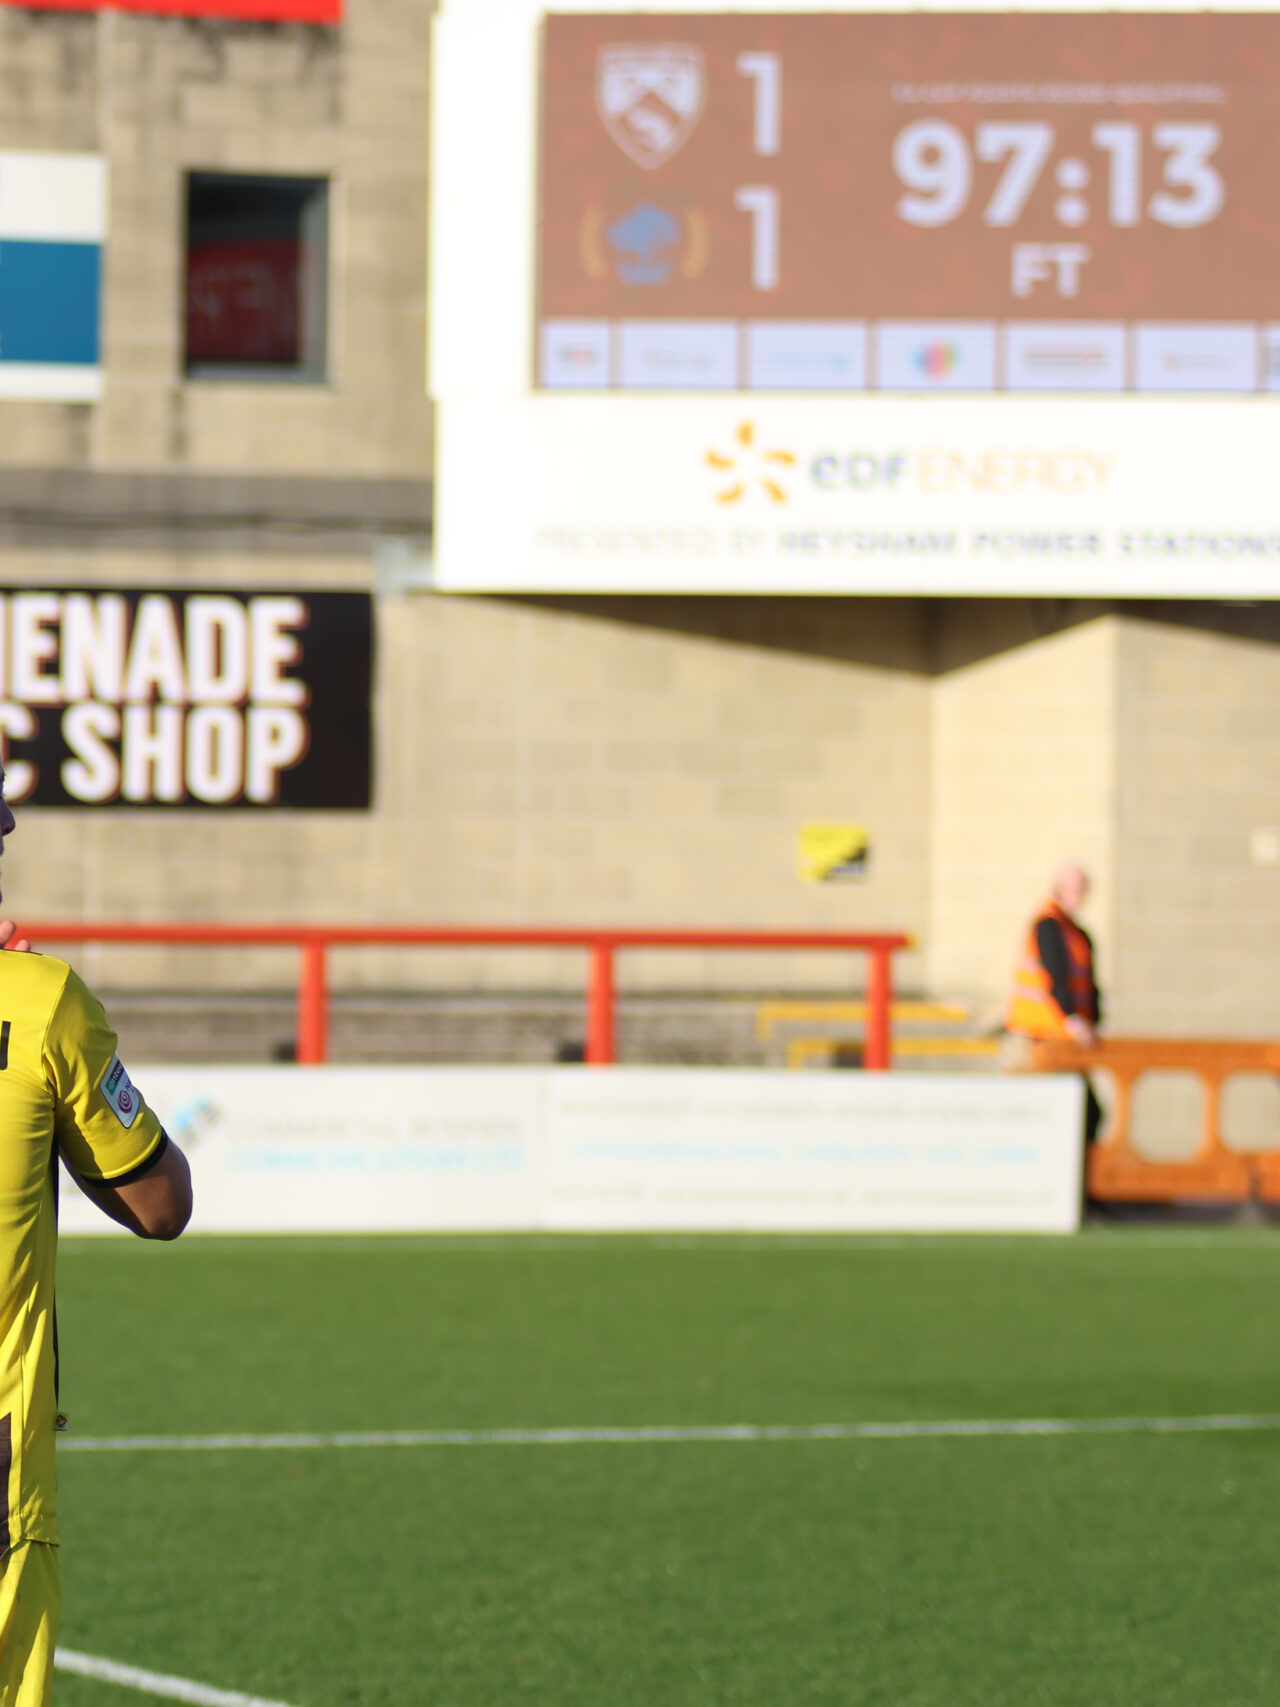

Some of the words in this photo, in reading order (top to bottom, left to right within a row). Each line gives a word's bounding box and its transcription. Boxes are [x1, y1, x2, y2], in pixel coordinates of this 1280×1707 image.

[736, 50, 783, 156] 1
[892, 116, 1225, 229] 97:13
[734, 186, 780, 291] 1
[1011, 242, 1091, 297] FT
[916, 447, 1117, 495] ENERGY
[968, 523, 1106, 562] POWER
[60, 700, 310, 804] SHOP
